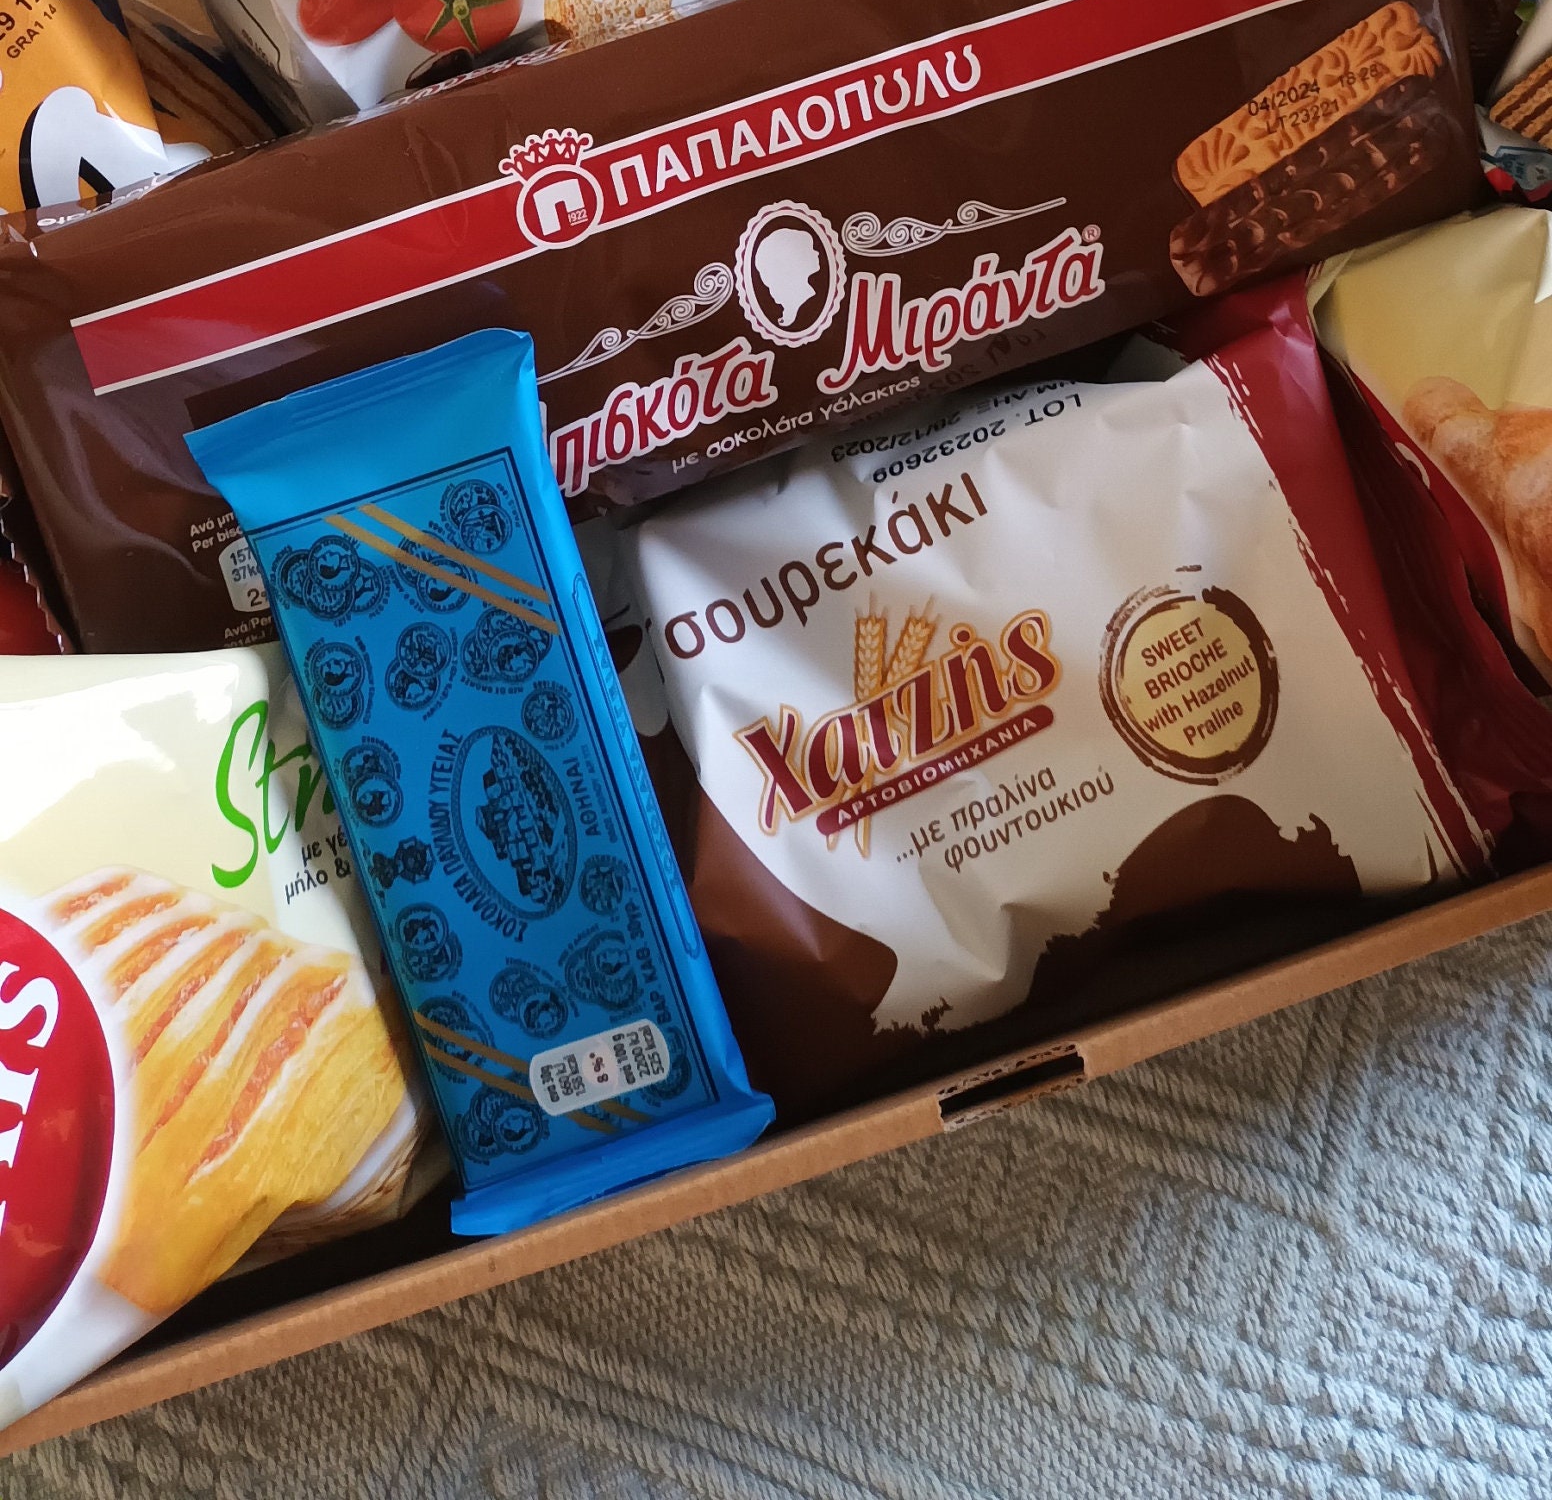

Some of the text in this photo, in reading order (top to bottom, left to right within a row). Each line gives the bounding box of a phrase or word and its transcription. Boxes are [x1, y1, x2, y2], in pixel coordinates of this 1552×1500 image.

[1247, 77, 1321, 117] 04/2024
[567, 208, 589, 226] 1922
[545, 228, 1106, 498] πισκότα Μιράντα
[671, 374, 923, 474] με σοκολάτα γάλακτος
[872, 393, 1085, 484] LOT. 20232609
[191, 536, 214, 553] Per
[217, 511, 235, 528] μπ
[660, 471, 989, 662] σουρεκάκι
[1140, 617, 1207, 668] SWEET
[1144, 640, 1228, 701] BRIOCHE
[1143, 654, 1256, 735] with Hazelnut
[1182, 699, 1244, 747] Praline
[211, 700, 336, 889] Str
[430, 728, 464, 795] ΥΓΕΙΑΣ
[836, 716, 1038, 825] ΑΡΤΟΒΙΟΜΗΧΑΝΙΑ
[563, 756, 601, 838] ΑΘΗΝΑΙ
[942, 764, 1117, 874] φουντουκιού
[950, 764, 1058, 836] πραλίνα
[302, 845, 323, 867] με
[428, 798, 466, 877] ΠΑΥΛΙΔΟΥ
[284, 857, 352, 905] μήλο &
[453, 873, 529, 943] ΣΟΚΟΛΑΤΑ
[631, 1045, 651, 1078] 2200
[638, 1024, 657, 1052] kcal
[596, 1072, 609, 1083] 8
